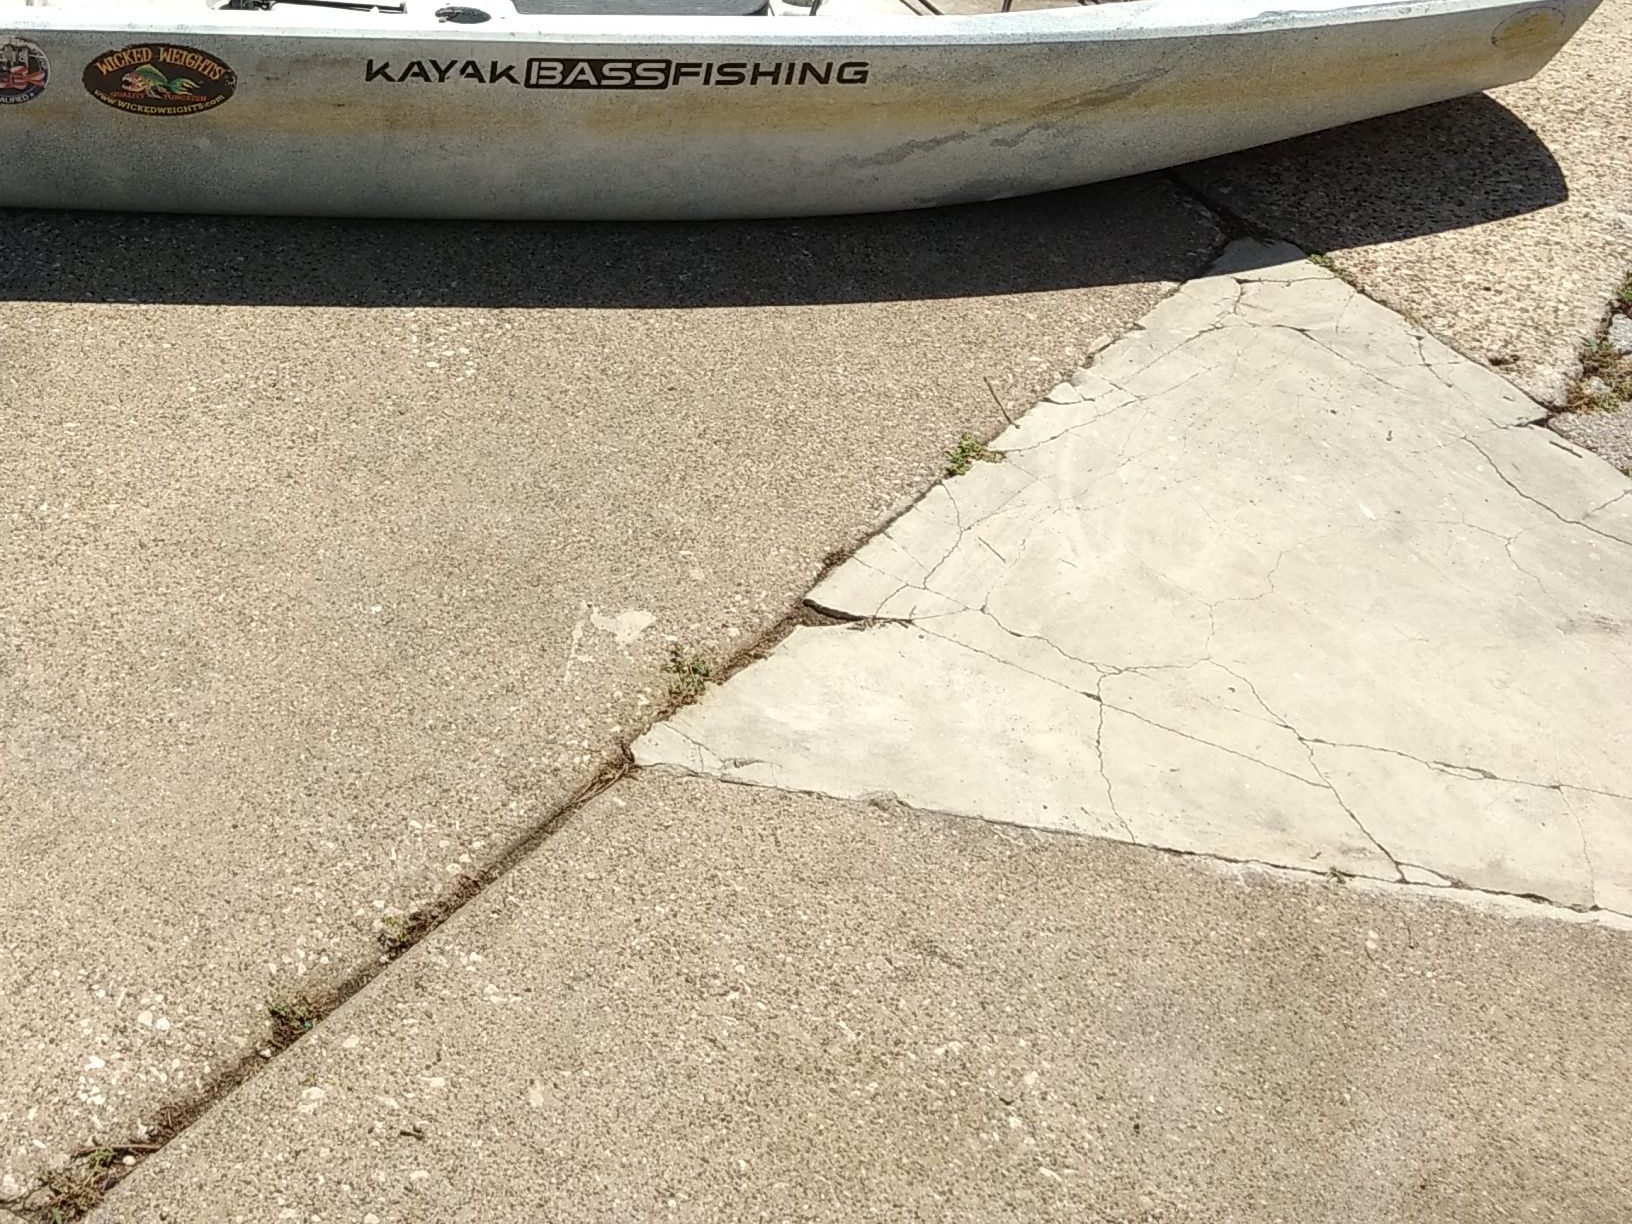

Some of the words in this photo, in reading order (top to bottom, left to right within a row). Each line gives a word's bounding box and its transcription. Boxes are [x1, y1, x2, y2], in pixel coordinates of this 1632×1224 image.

[95, 47, 152, 76] WICKED
[159, 46, 226, 80] WEIGHTS
[365, 58, 521, 83] KAYAK
[530, 60, 667, 86] BASS
[672, 61, 871, 86] FISHING
[94, 89, 226, 115] www.WICKEDWEIGHTS.com
